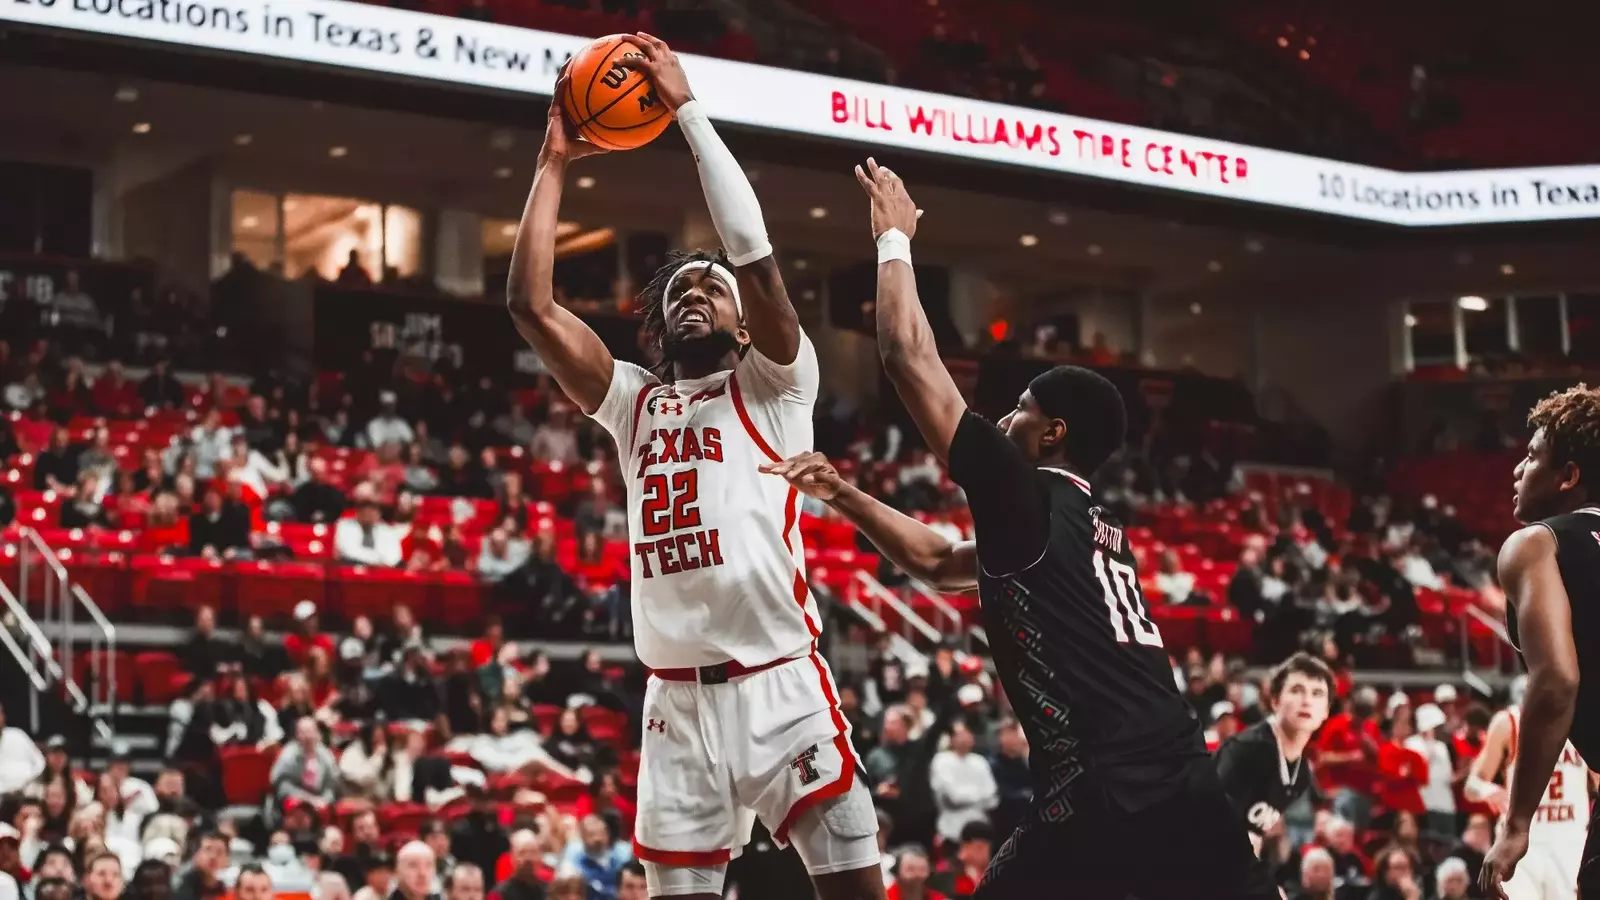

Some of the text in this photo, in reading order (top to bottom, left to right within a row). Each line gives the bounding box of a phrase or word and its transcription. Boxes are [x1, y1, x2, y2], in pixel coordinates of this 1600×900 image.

[262, 5, 294, 38] in
[308, 13, 401, 54] Texas
[415, 27, 439, 58] &
[456, 35, 531, 71] New
[831, 91, 1248, 184] BILL WILLIAMS TIRE CENTER
[1318, 172, 1600, 212] 10 Locations in Texa
[641, 467, 702, 537] 22
[634, 528, 725, 579] TECH
[1092, 549, 1164, 649] 10
[1549, 770, 1564, 800] 2
